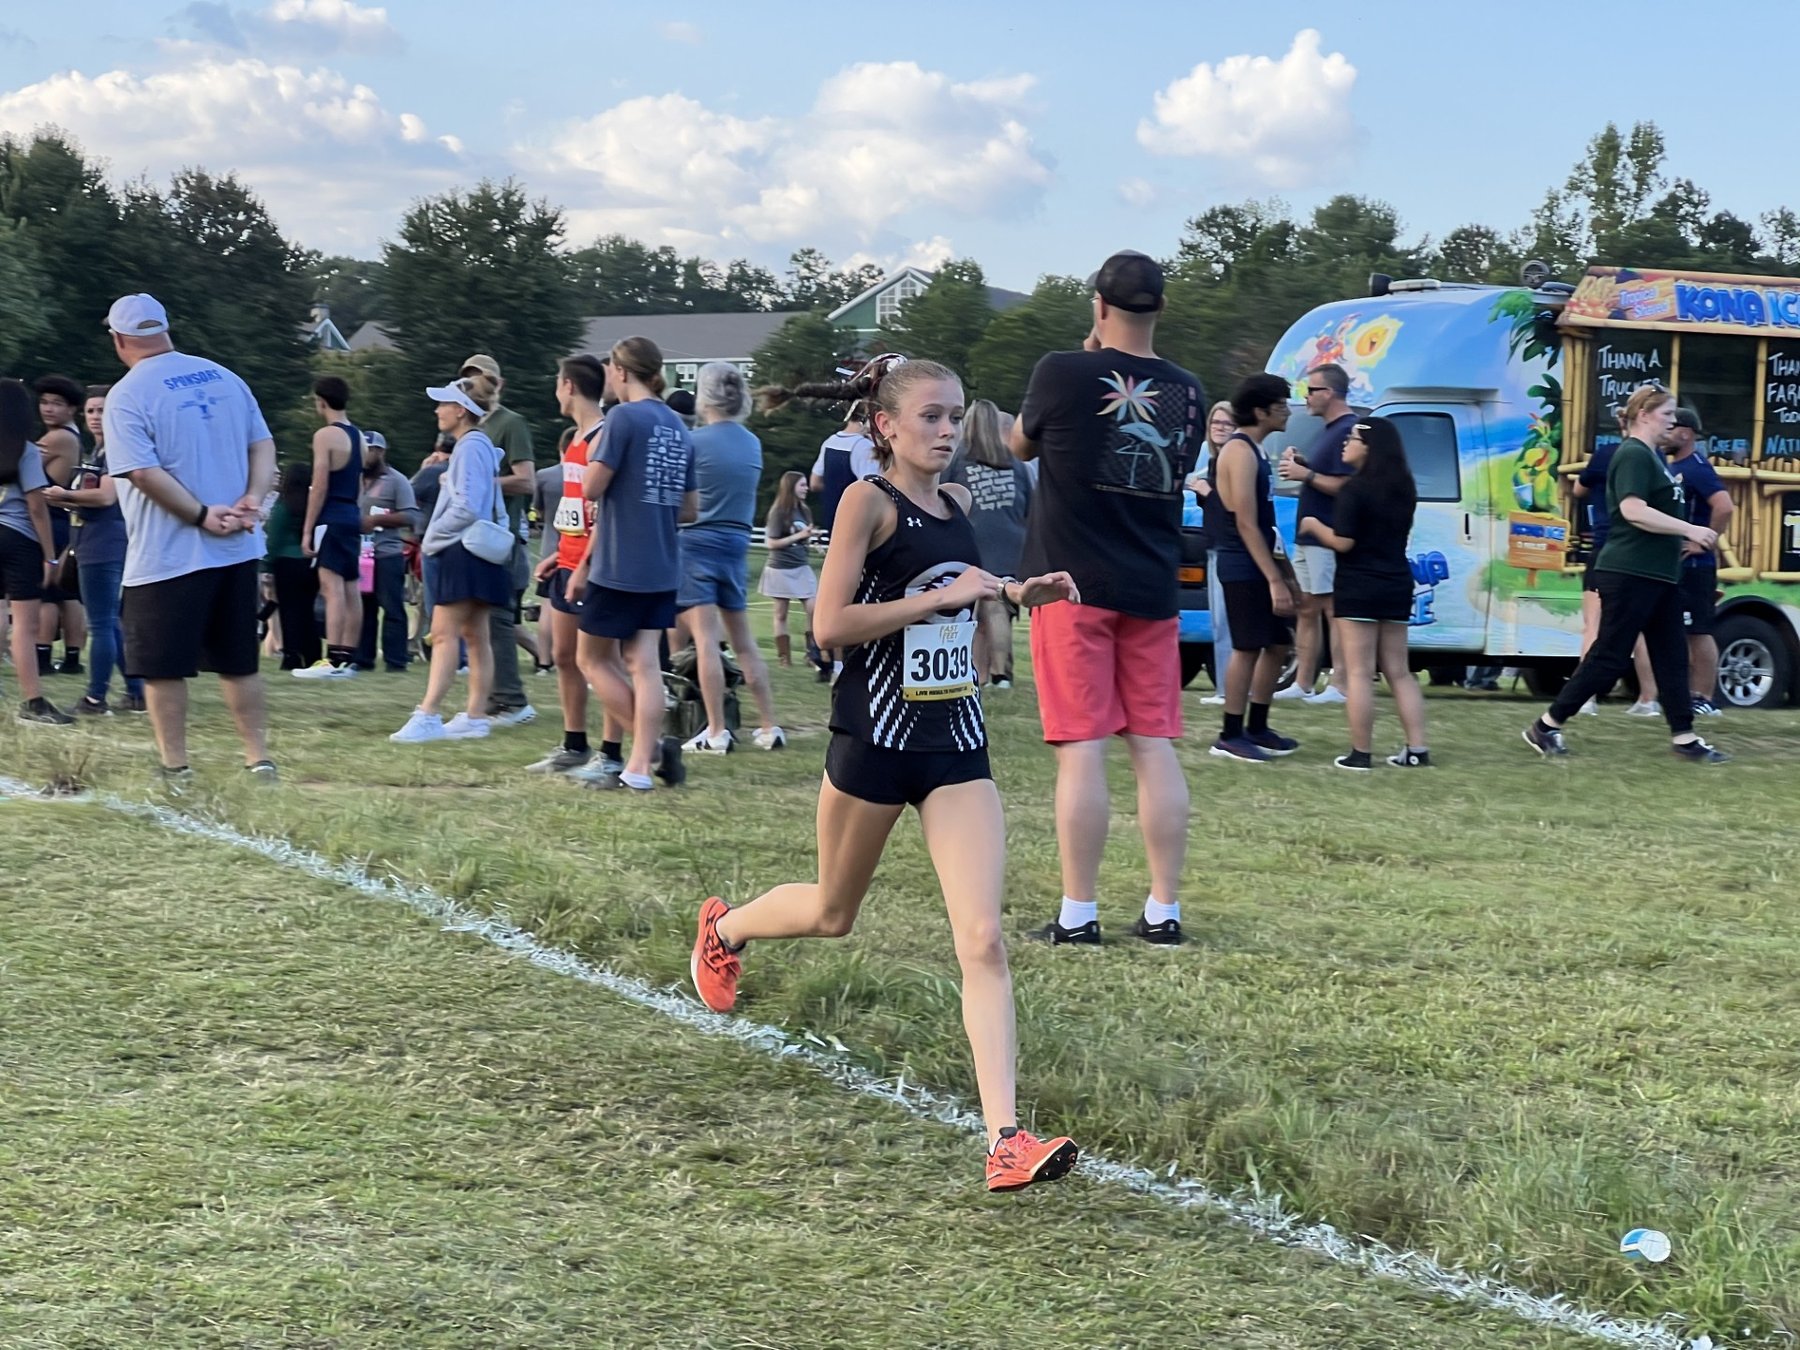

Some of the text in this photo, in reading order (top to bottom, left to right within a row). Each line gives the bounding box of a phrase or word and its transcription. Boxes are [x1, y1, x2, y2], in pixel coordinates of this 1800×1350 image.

[1674, 281, 1800, 327] KONA IC
[1648, 348, 1664, 368] A
[163, 369, 223, 390] SPONSORS
[1598, 374, 1665, 400] TRUCR
[1766, 382, 1800, 406] FAR
[910, 645, 969, 682] 3039
